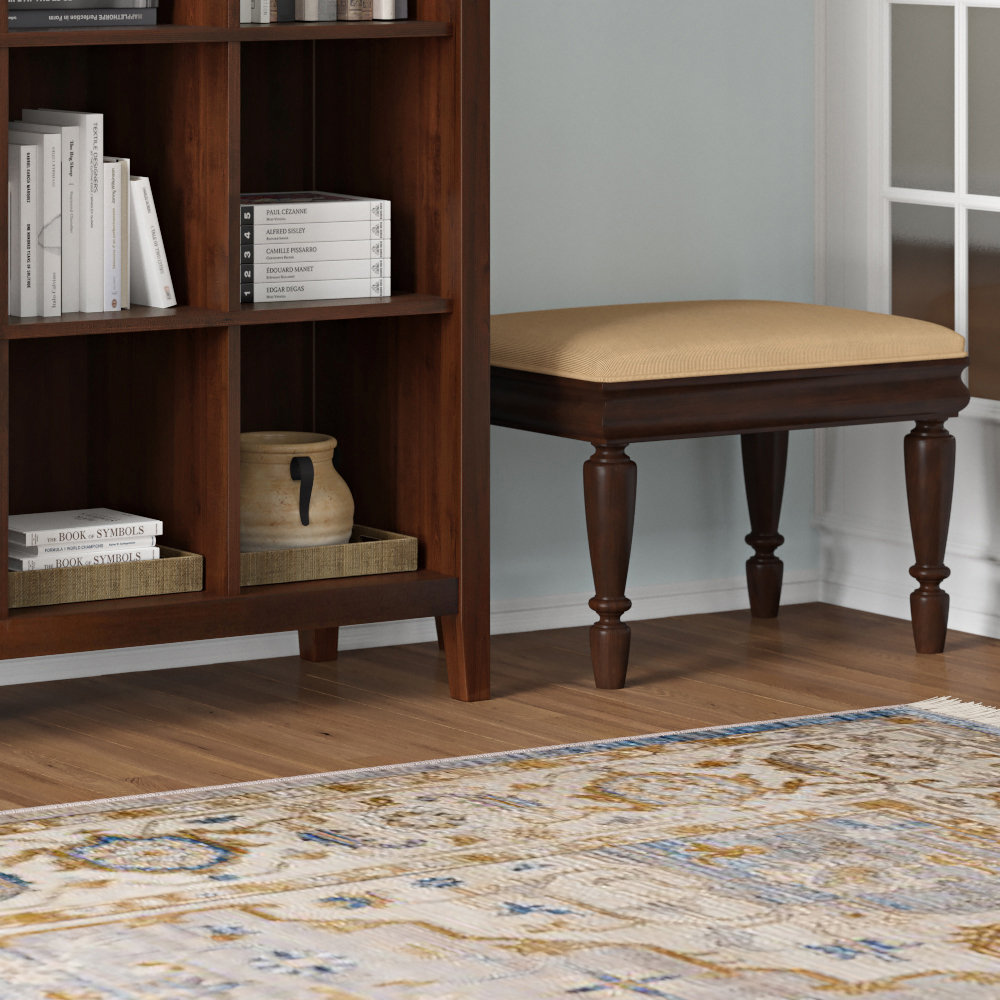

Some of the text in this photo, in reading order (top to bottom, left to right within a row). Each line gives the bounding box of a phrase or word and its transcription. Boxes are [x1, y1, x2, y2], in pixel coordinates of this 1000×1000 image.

[243, 231, 251, 239] 4
[290, 246, 317, 254] PISSARRO
[59, 530, 86, 541] BOOK
[96, 525, 145, 538] SYMBOLS
[56, 557, 83, 568] BOOK
[93, 551, 141, 565] SYMBOLS
